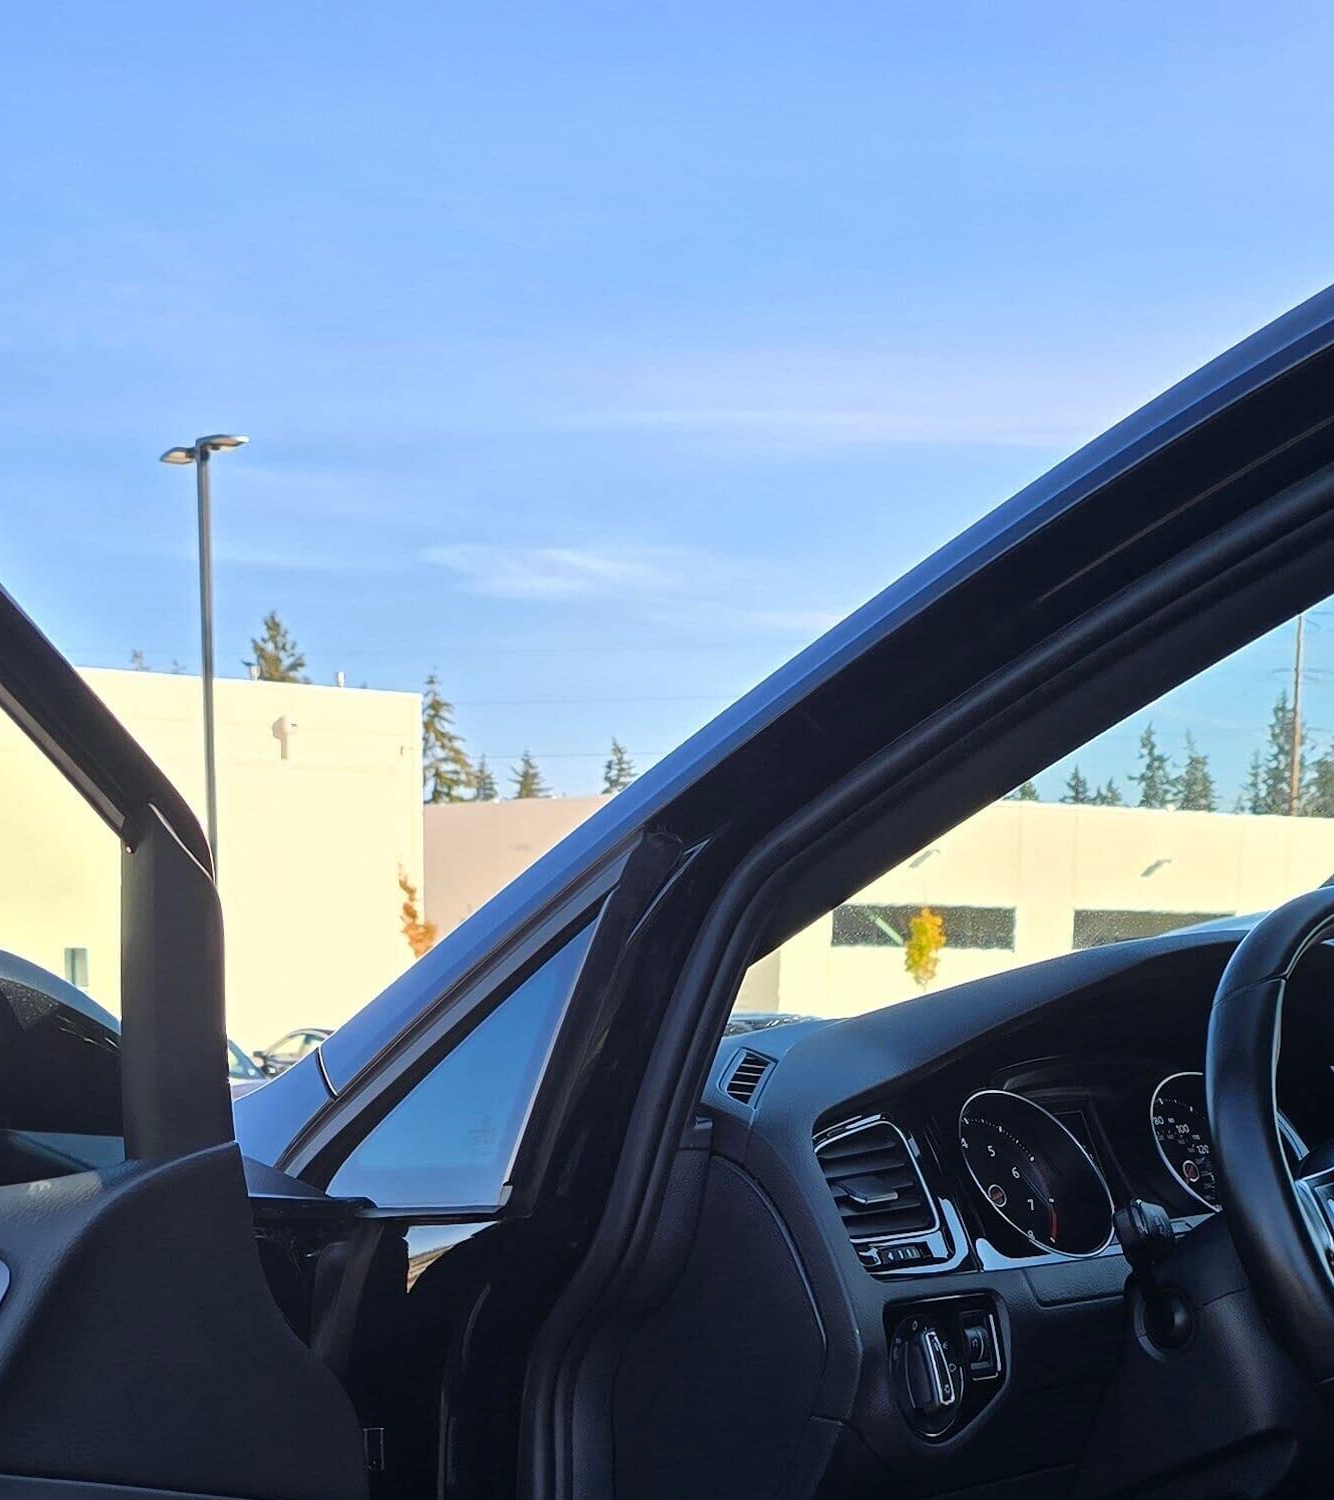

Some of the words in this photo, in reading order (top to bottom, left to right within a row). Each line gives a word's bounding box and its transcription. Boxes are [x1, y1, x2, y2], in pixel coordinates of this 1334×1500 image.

[986, 1145, 996, 1158] 5
[1011, 1166, 1021, 1179] 6
[1027, 1198, 1035, 1212] 7
